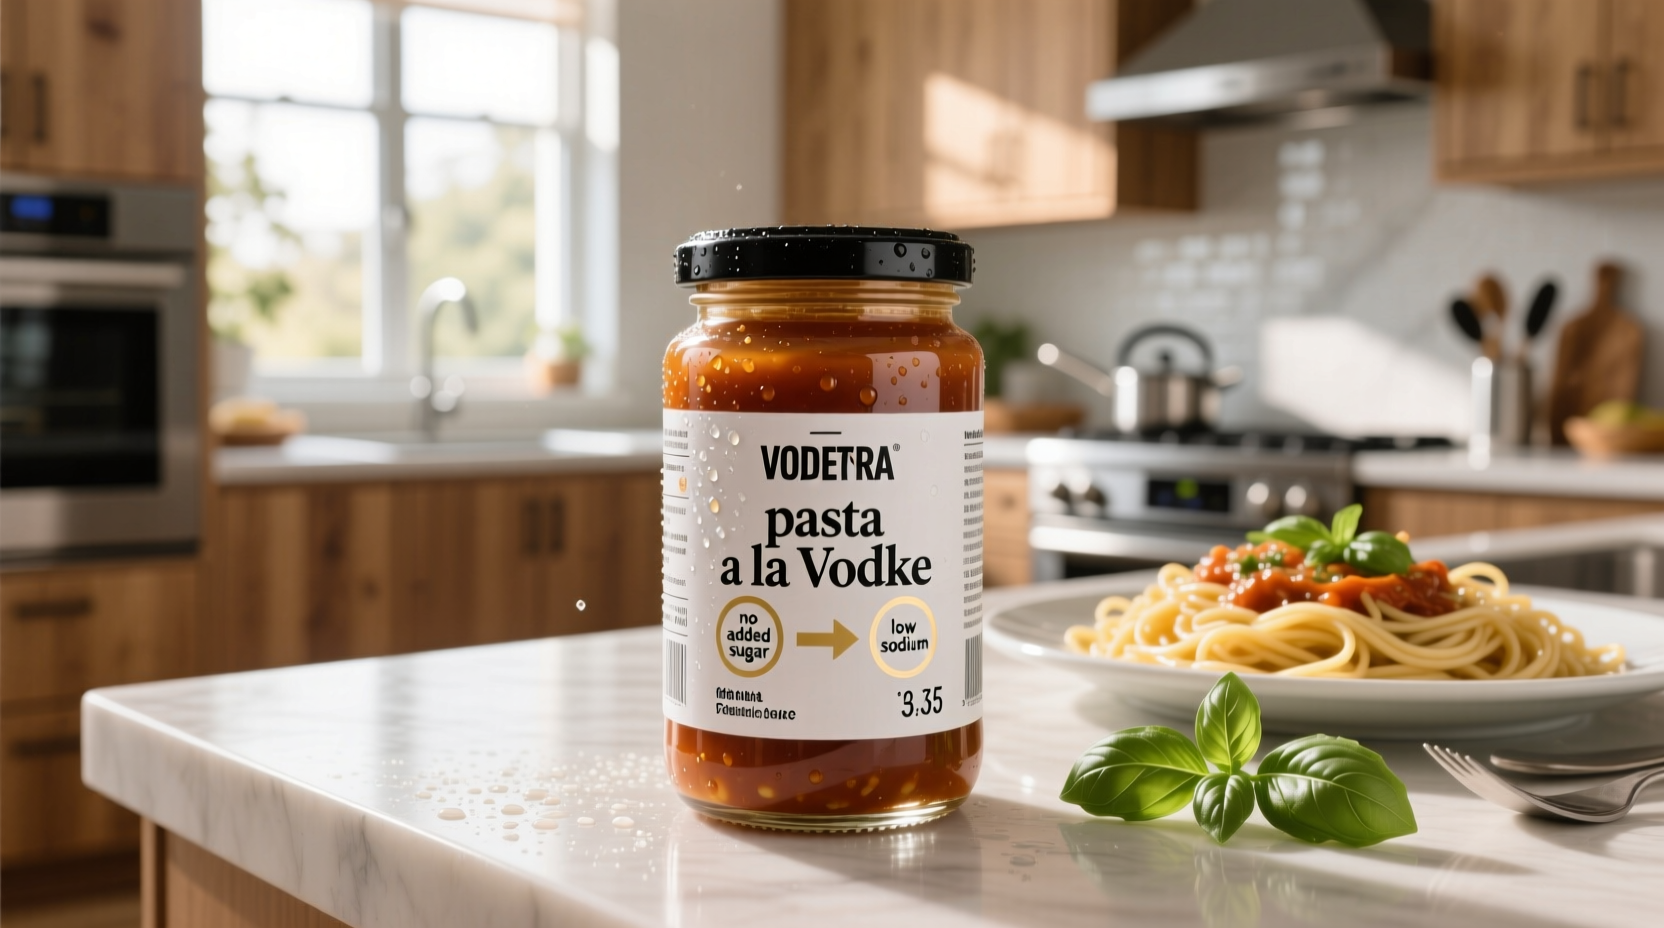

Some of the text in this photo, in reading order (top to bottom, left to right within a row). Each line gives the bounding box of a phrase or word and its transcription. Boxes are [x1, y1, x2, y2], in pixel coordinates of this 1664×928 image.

[764, 501, 885, 548] pasta
[720, 543, 932, 588] a la Vodke
[739, 613, 758, 625] no
[891, 618, 917, 635] low
[726, 627, 771, 643] added
[880, 637, 929, 653] sodium
[728, 645, 770, 663] sugar
